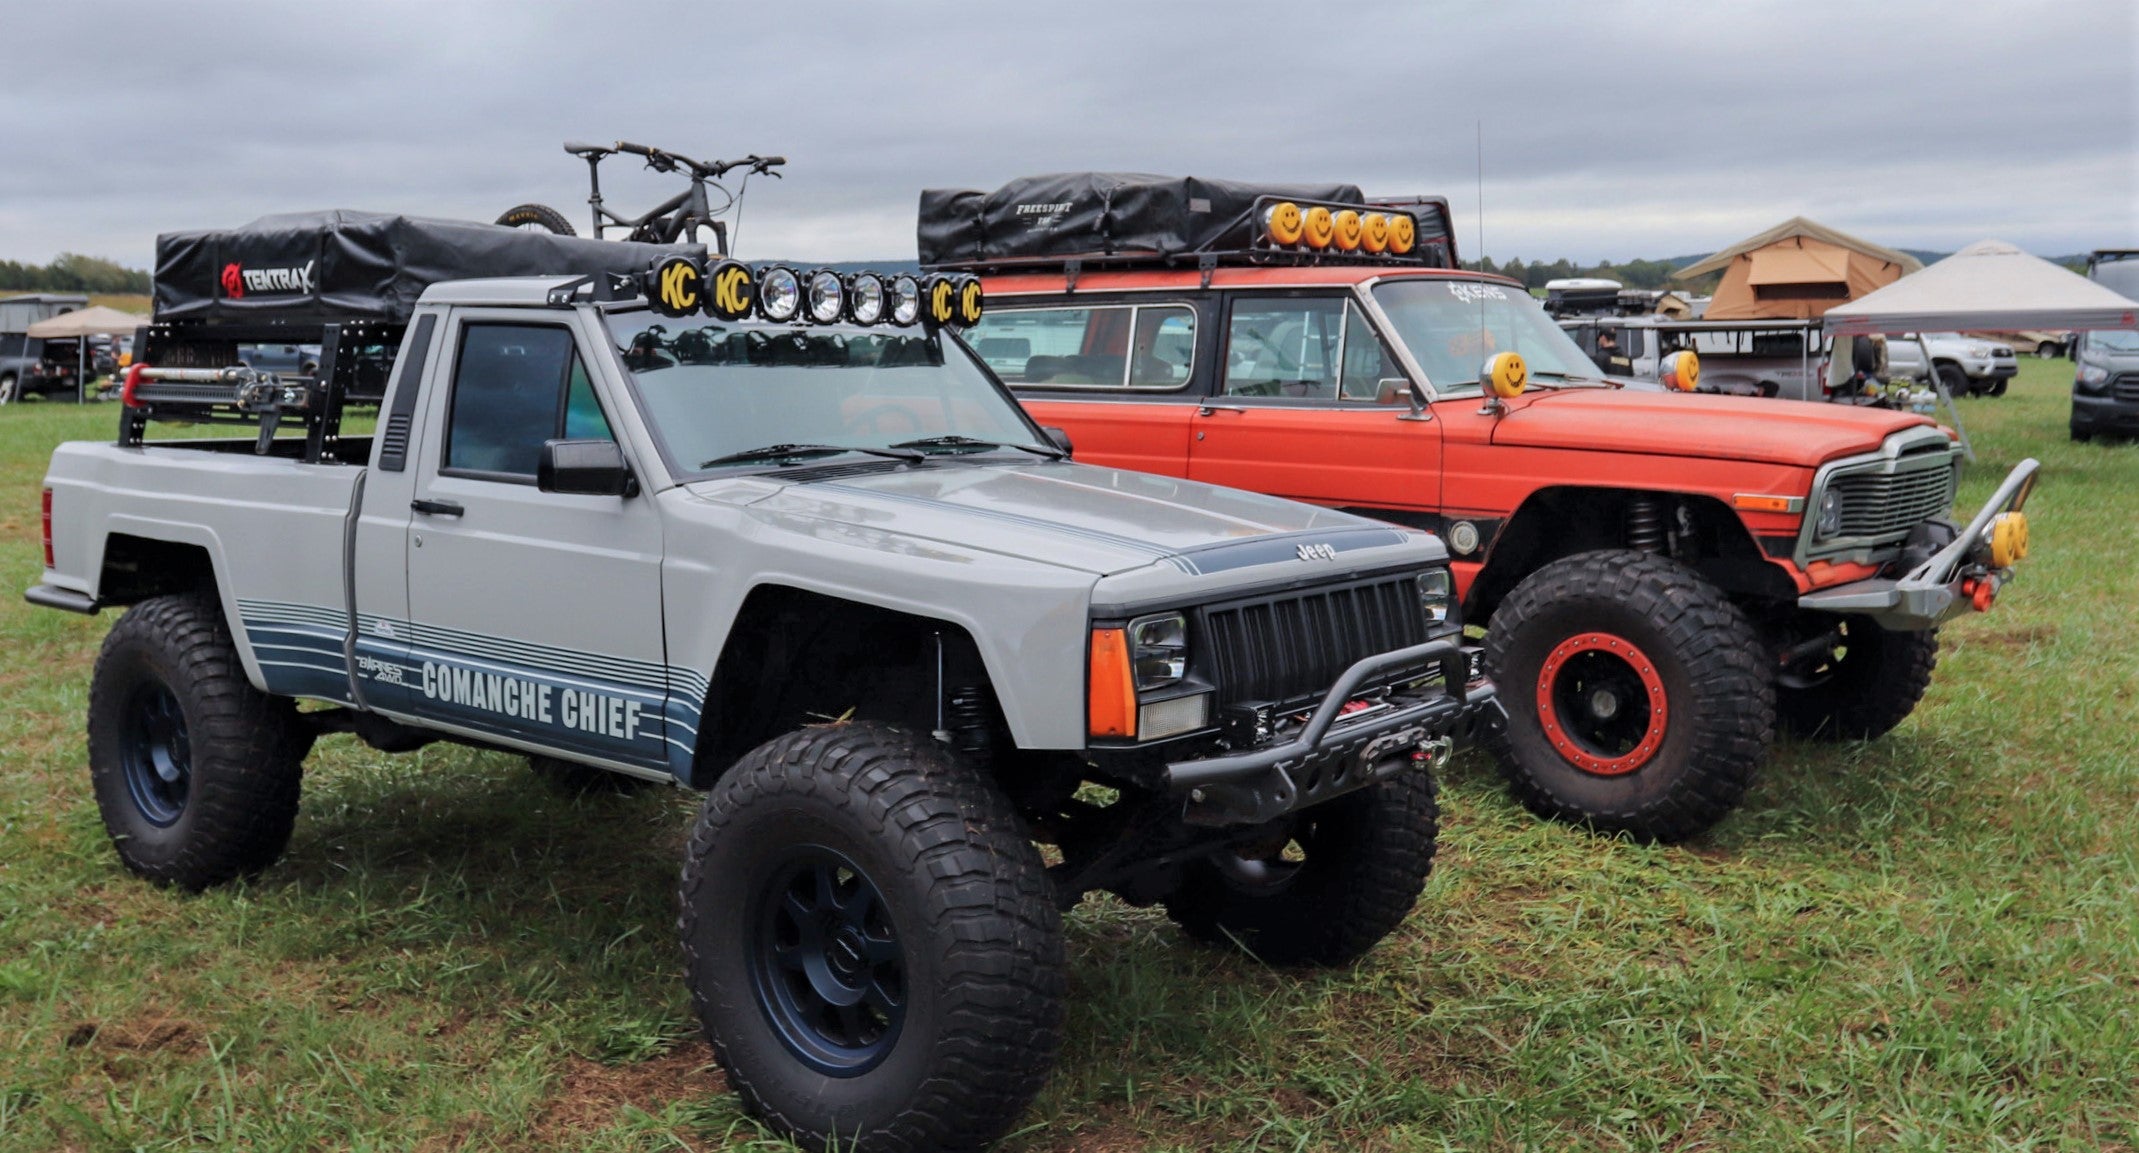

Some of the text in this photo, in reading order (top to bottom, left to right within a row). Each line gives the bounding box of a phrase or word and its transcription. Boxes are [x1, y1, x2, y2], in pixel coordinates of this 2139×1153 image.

[242, 259, 315, 295] TENTRAX
[661, 262, 696, 310] KC
[716, 267, 750, 314] KC
[932, 281, 952, 322] KC
[962, 282, 981, 322] KC
[1296, 543, 1336, 561] Jeep
[358, 656, 403, 676] BARNES
[421, 661, 642, 740] COMANCHE CHIEF
